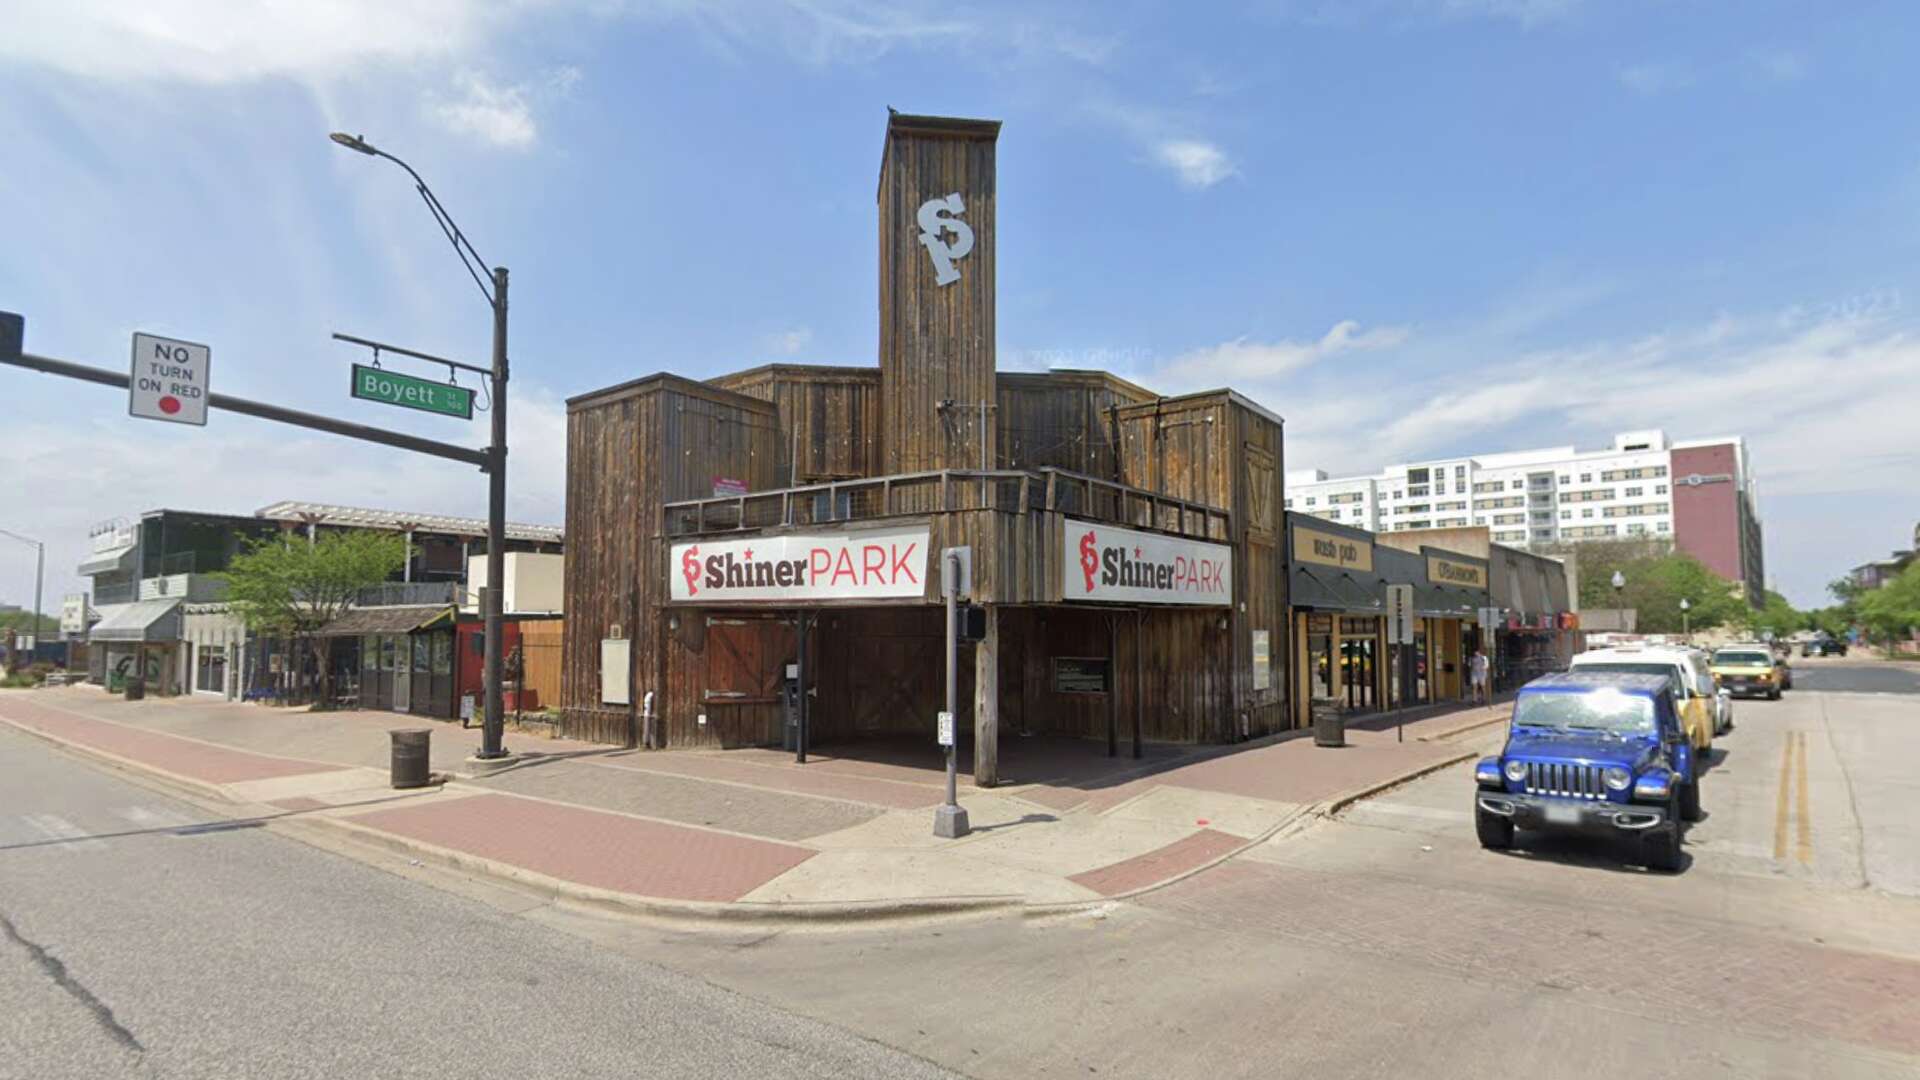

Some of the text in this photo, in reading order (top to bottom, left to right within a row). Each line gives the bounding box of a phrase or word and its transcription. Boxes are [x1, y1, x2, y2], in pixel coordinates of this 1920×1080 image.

[155, 343, 189, 364] NO
[150, 361, 193, 381] TURN
[138, 377, 202, 399] ON RED
[364, 375, 434, 404] Boyett
